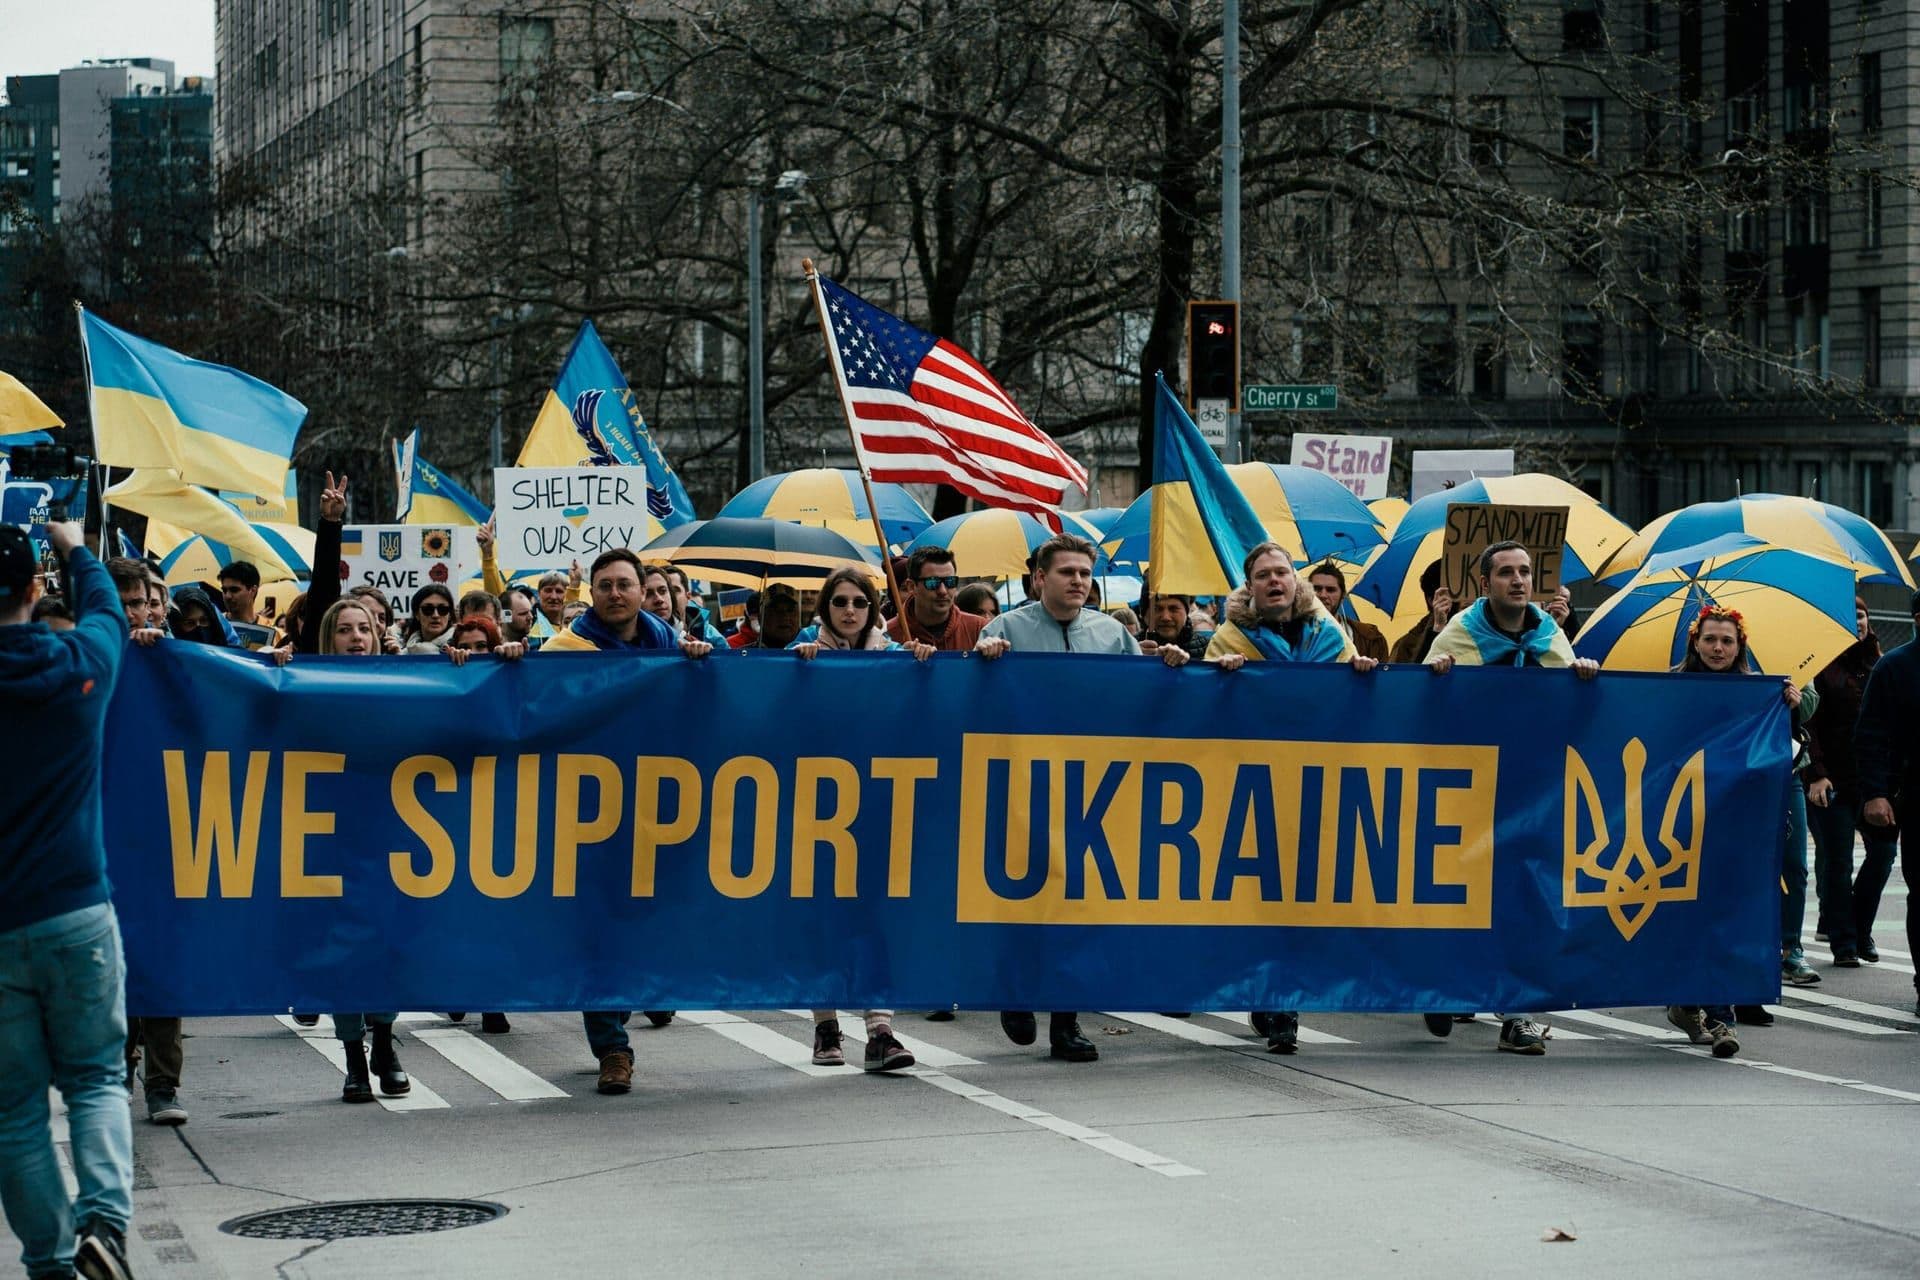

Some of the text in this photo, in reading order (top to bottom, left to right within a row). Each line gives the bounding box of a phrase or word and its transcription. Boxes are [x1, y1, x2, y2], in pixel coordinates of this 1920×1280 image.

[1248, 387, 1335, 409] Cherry St 600
[1302, 438, 1388, 475] Stand
[512, 474, 635, 510] SHELTER
[523, 526, 634, 556] OUR SKY
[363, 570, 419, 588] SAVE
[1445, 551, 1559, 598] UKNE
[162, 749, 1473, 906] WE SUPPORT UKRAINE
